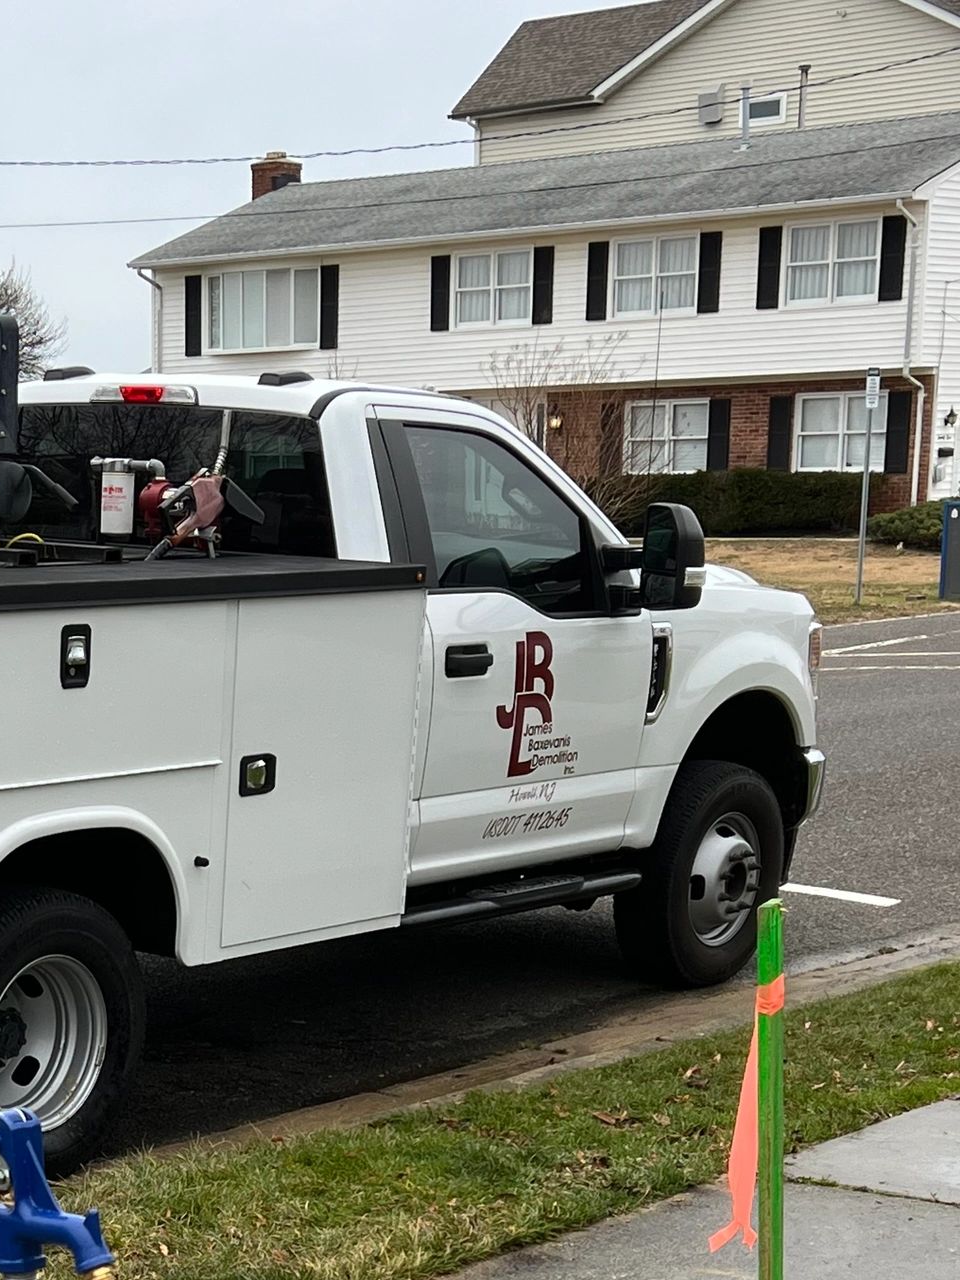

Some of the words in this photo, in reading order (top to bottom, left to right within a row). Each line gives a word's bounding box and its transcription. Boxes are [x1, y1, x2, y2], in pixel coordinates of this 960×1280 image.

[523, 723, 553, 737] James
[528, 735, 571, 752] Baxevanis
[531, 750, 579, 767] Demolition
[539, 782, 557, 802] NJ
[482, 813, 527, 840] USDOT
[523, 807, 573, 834] 4112645
